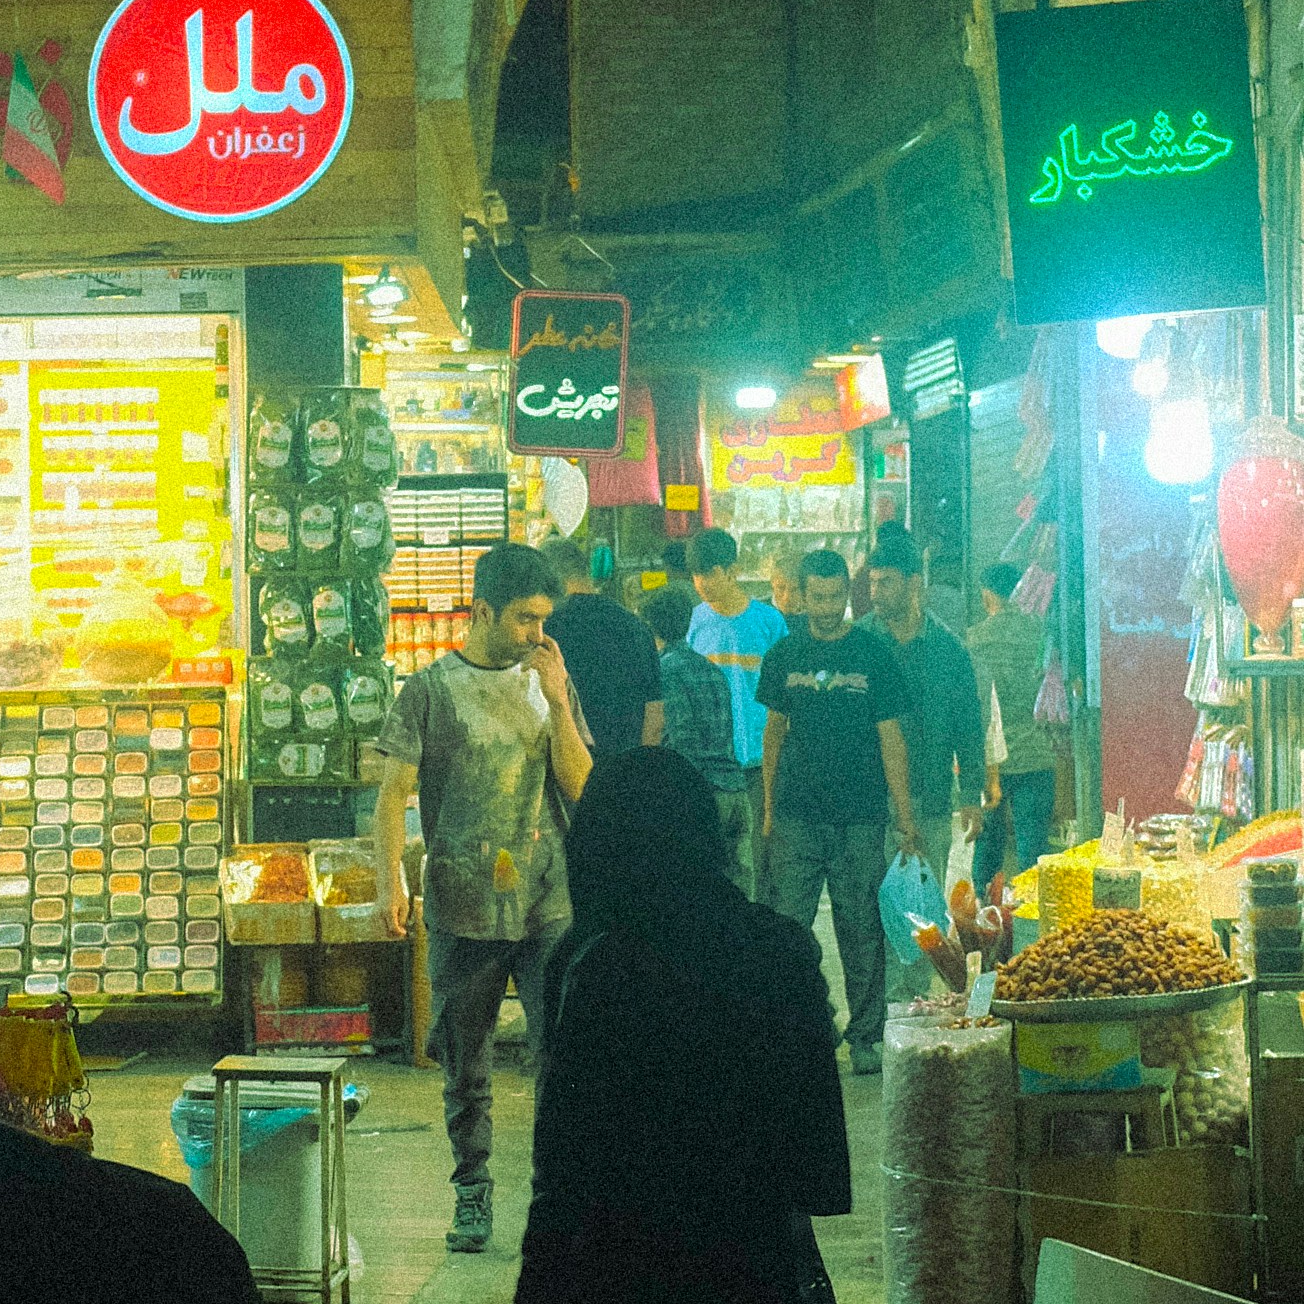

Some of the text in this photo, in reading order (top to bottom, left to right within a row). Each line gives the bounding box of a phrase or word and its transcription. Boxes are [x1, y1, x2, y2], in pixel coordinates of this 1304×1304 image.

[117, 7, 327, 156] ملل
[207, 123, 306, 160] زعفران
[1029, 109, 1233, 204] خشکبار
[516, 377, 621, 420] تجریش
